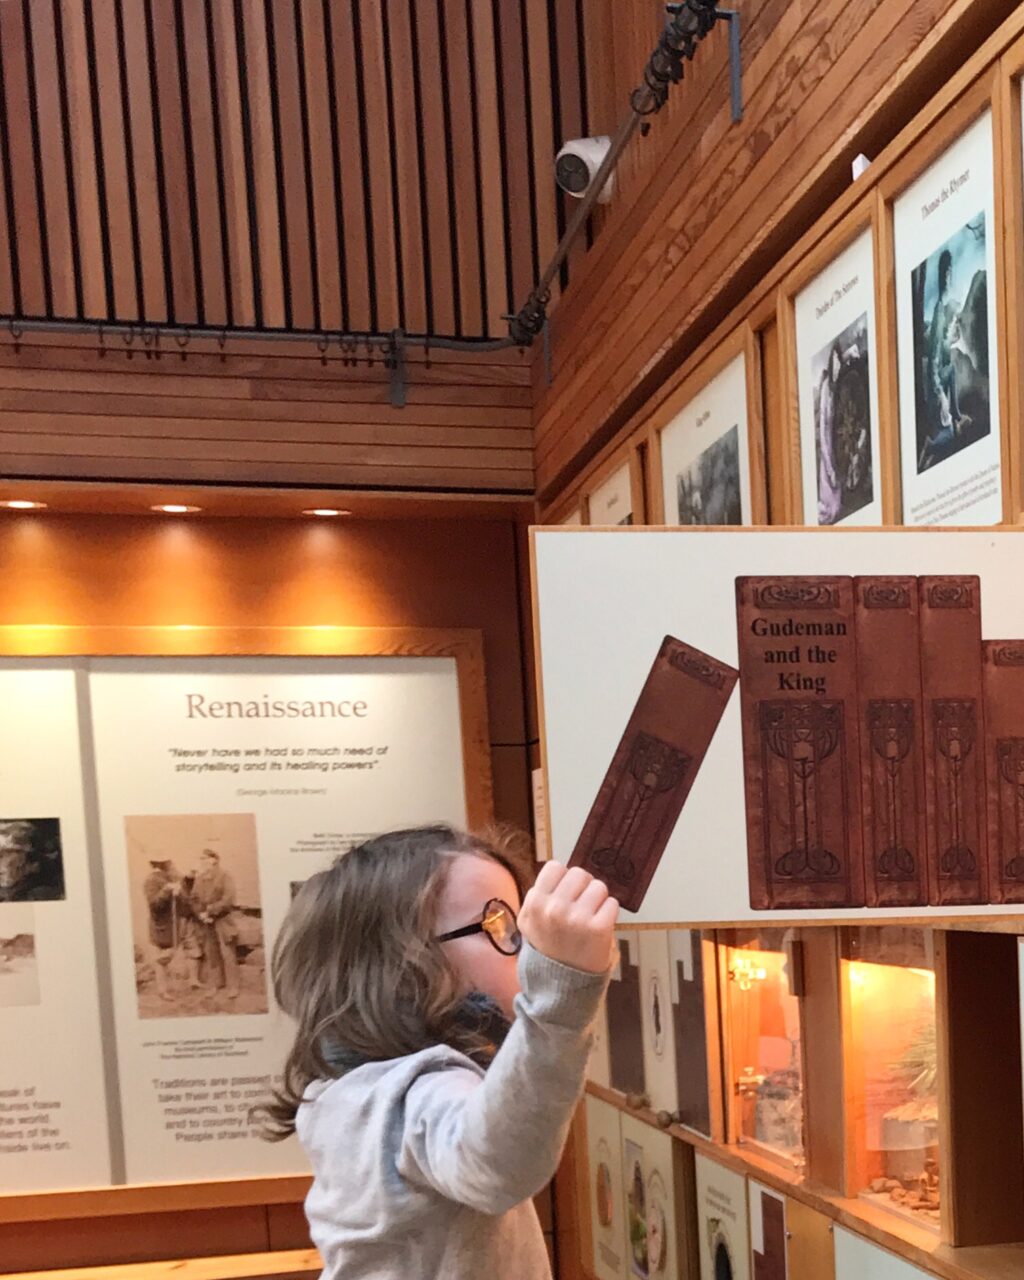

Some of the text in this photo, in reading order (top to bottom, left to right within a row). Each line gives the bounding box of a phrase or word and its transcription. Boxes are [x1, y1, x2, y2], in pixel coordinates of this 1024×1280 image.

[751, 618, 847, 637] Gudeman
[764, 645, 837, 663] and the
[778, 672, 826, 694] King
[186, 693, 368, 719] Renaissance
[212, 748, 241, 758] have
[244, 749, 261, 758] we
[264, 747, 288, 757] had
[292, 748, 304, 757] so
[307, 746, 340, 757] much
[343, 746, 373, 756] need
[376, 746, 389, 756] of
[175, 761, 239, 773] storytelling
[243, 761, 267, 772] and
[270, 761, 282, 771] its
[285, 760, 328, 773] healing
